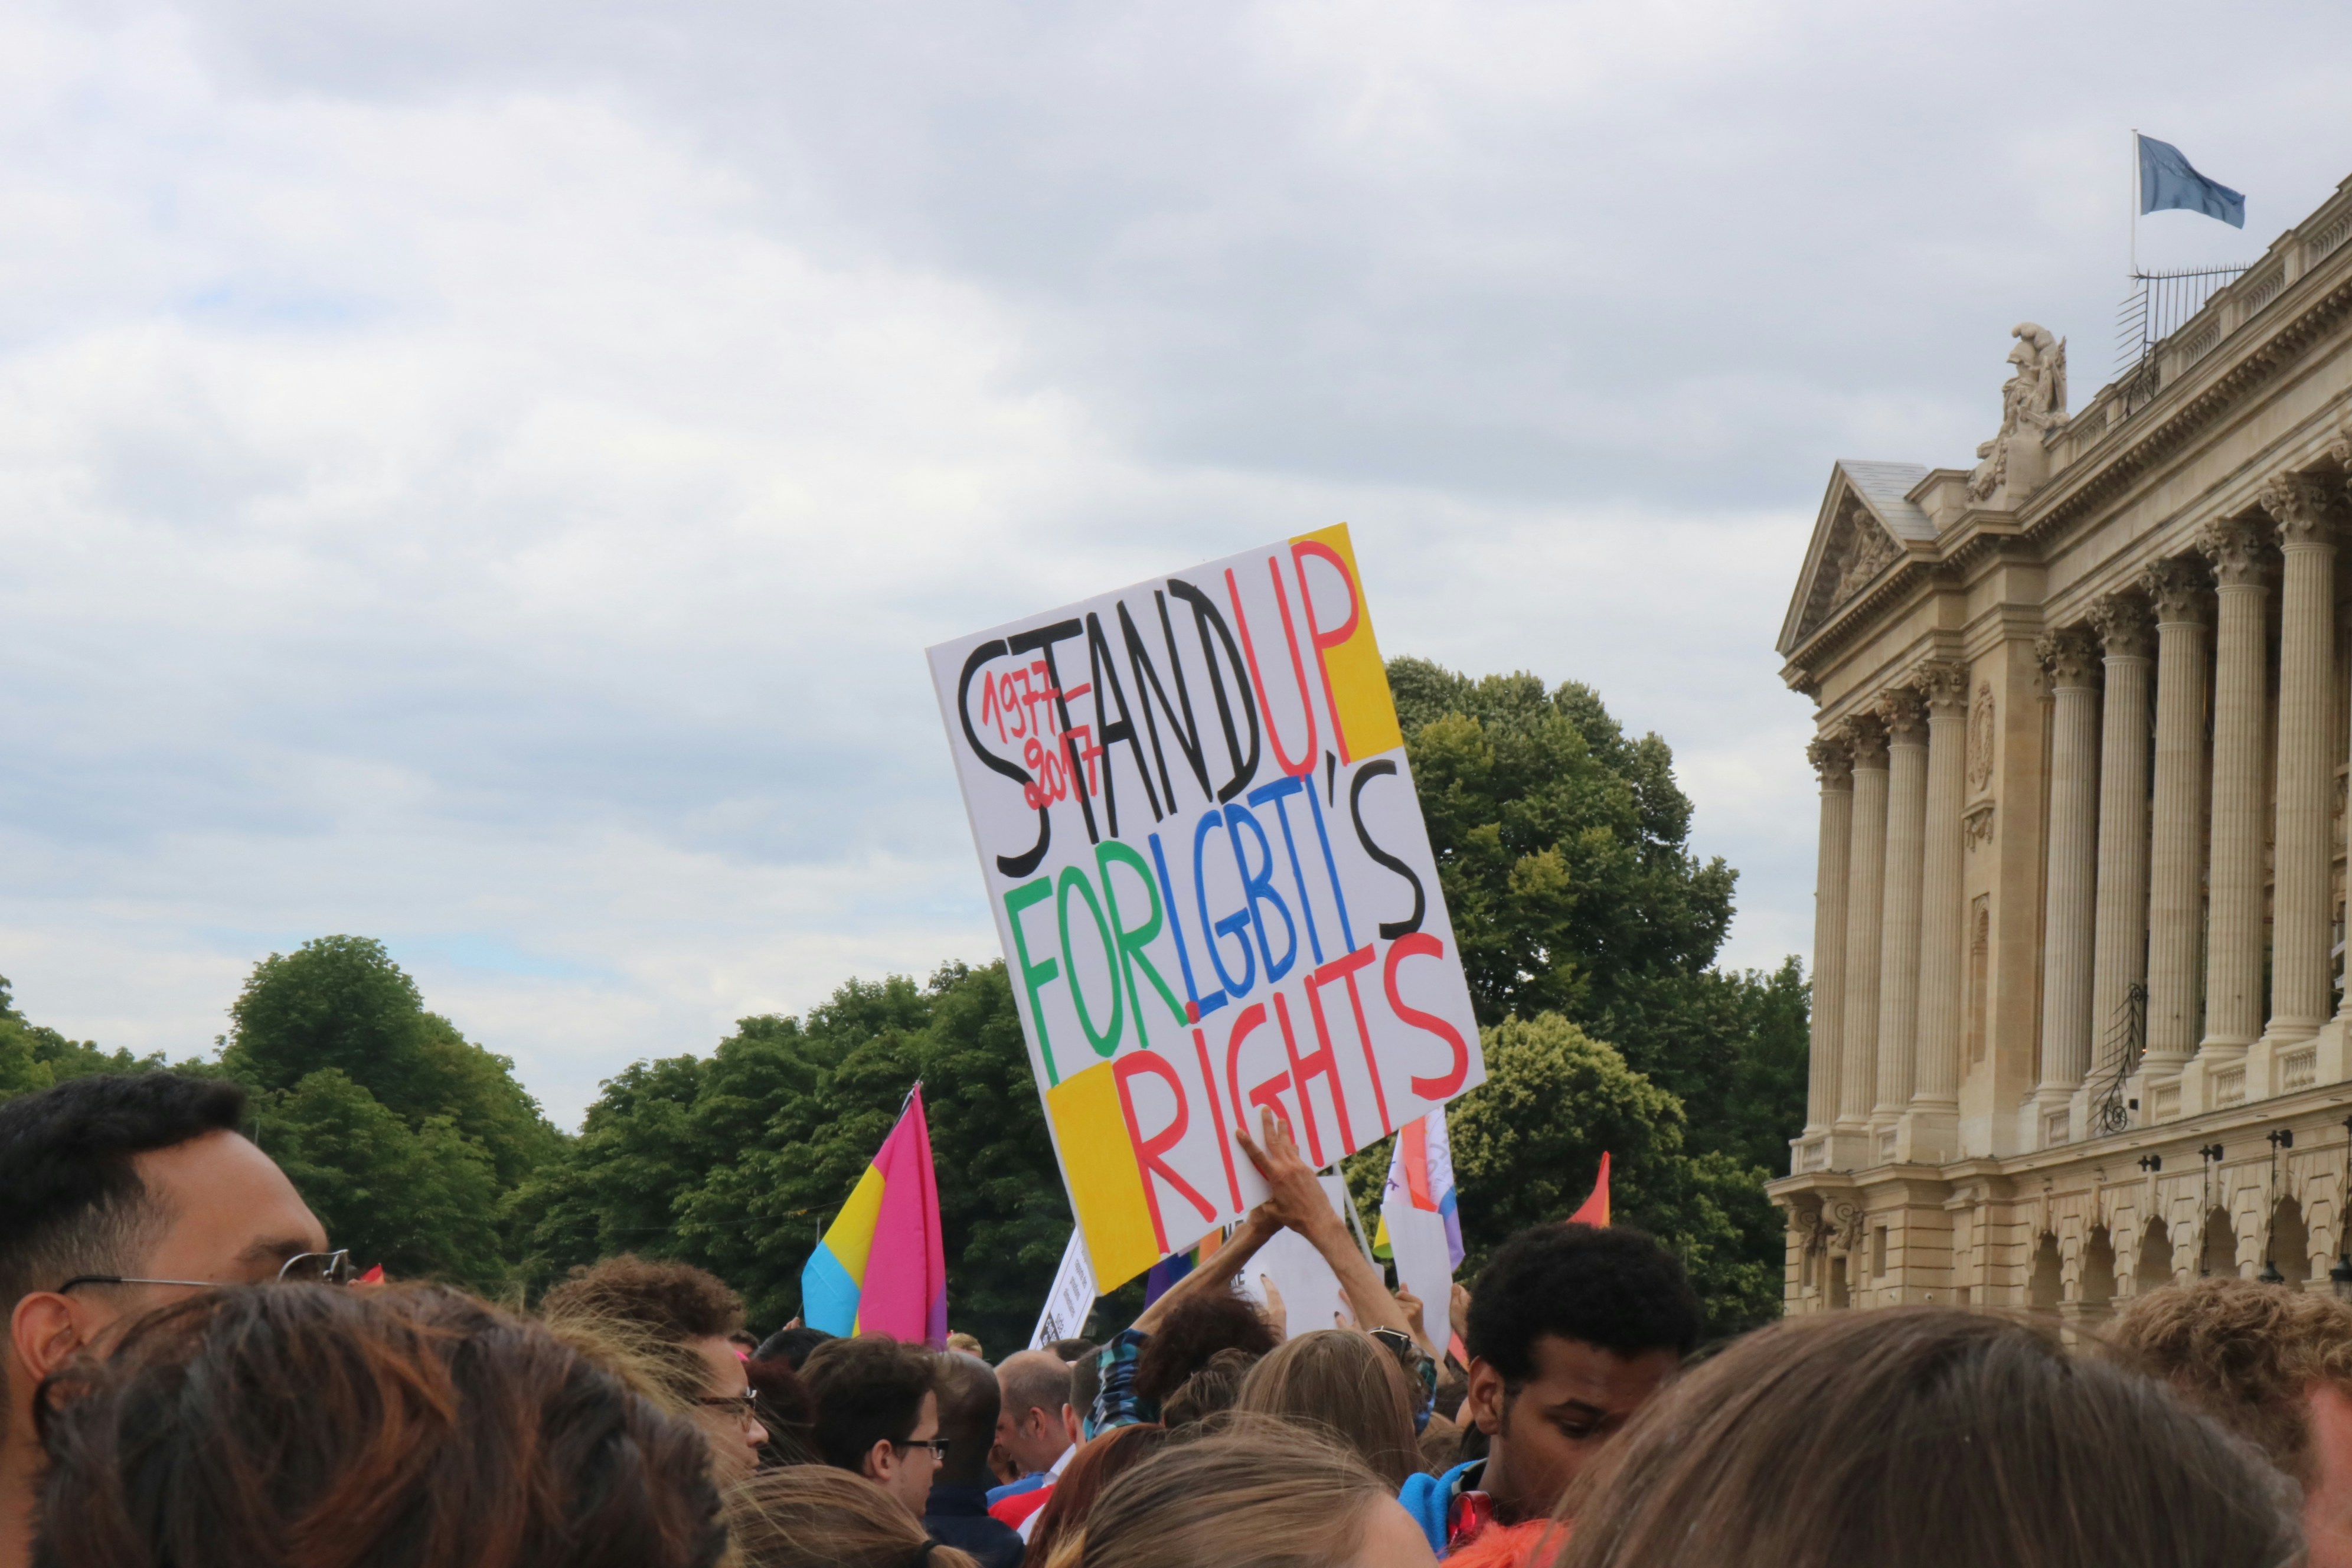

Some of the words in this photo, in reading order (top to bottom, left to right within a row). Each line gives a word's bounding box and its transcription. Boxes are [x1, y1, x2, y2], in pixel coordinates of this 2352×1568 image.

[957, 579, 1260, 878] STAND
[1224, 540, 1360, 782] UP
[982, 660, 1092, 744] 1977-
[1024, 724, 1103, 811] 2017
[1002, 840, 1190, 1087] FOR
[1148, 751, 1426, 1018] LGBTI'S
[1113, 932, 1470, 1255] RIGHTS
